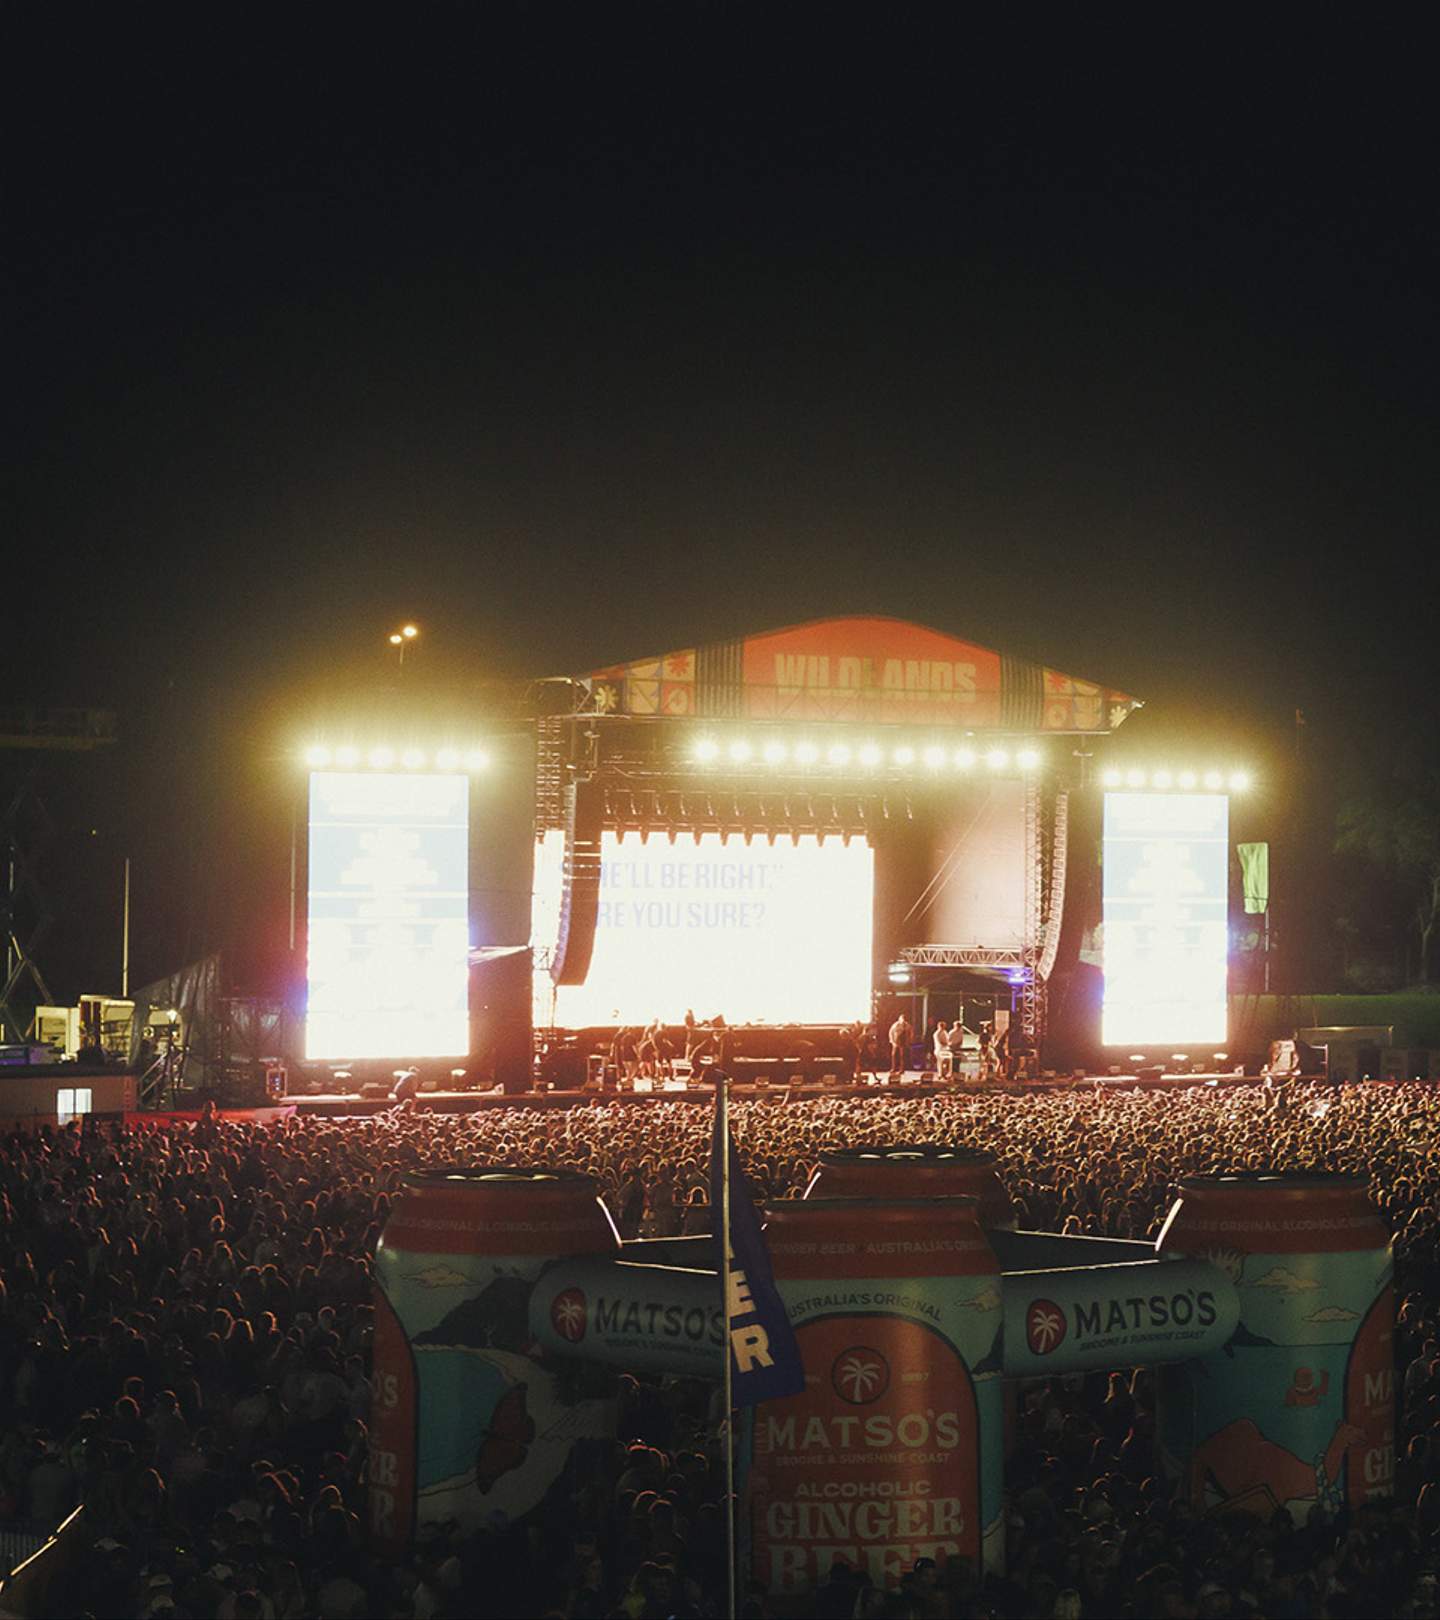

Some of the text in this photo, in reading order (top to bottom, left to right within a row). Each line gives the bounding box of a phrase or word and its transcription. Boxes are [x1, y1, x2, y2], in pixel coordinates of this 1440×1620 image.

[774, 653, 977, 703] WILDLANDS
[660, 863, 689, 889] BE
[632, 901, 681, 928] YOU
[688, 901, 766, 928] SURE?
[789, 1292, 942, 1322] USTRALIA'S ORIGINAL
[1074, 1287, 1216, 1340] MATSO'S
[767, 1408, 961, 1454] MATSO'S
[911, 1452, 951, 1465] COAST
[794, 1479, 933, 1498] ALCOHOLIC
[766, 1497, 965, 1541] GINGER
